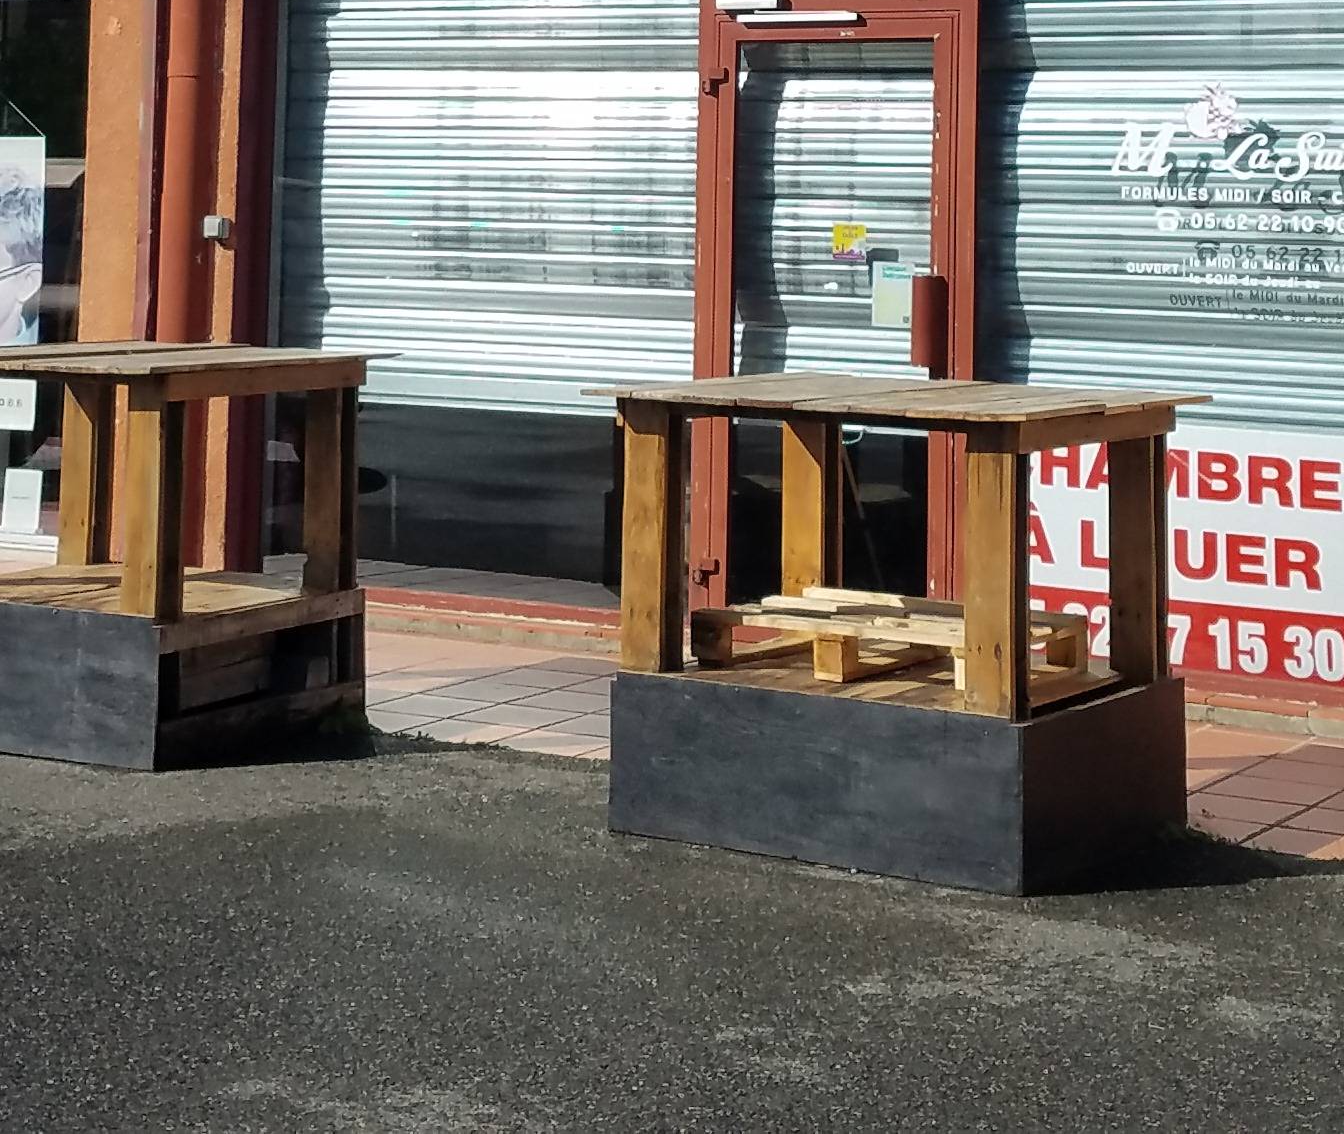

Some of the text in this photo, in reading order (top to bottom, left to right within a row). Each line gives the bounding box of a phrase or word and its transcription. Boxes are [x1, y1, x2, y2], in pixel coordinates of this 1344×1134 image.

[1213, 133, 1274, 179] La
[1121, 185, 1208, 202] FORMULES
[1215, 187, 1251, 203] MIDI
[1271, 189, 1312, 205] SOIR
[1190, 212, 1216, 230] 05
[1224, 213, 1249, 231] 62
[1257, 214, 1283, 232] 22
[1292, 216, 1314, 233] 10
[1126, 262, 1180, 275] OUVERT
[1205, 257, 1236, 270] MIDI
[1241, 258, 1258, 270] du
[1263, 259, 1300, 272] Mardi
[1304, 262, 1320, 273] au
[1030, 442, 1343, 513] HABRE
[1080, 519, 1322, 592] LUER
[1207, 616, 1269, 674] 15
